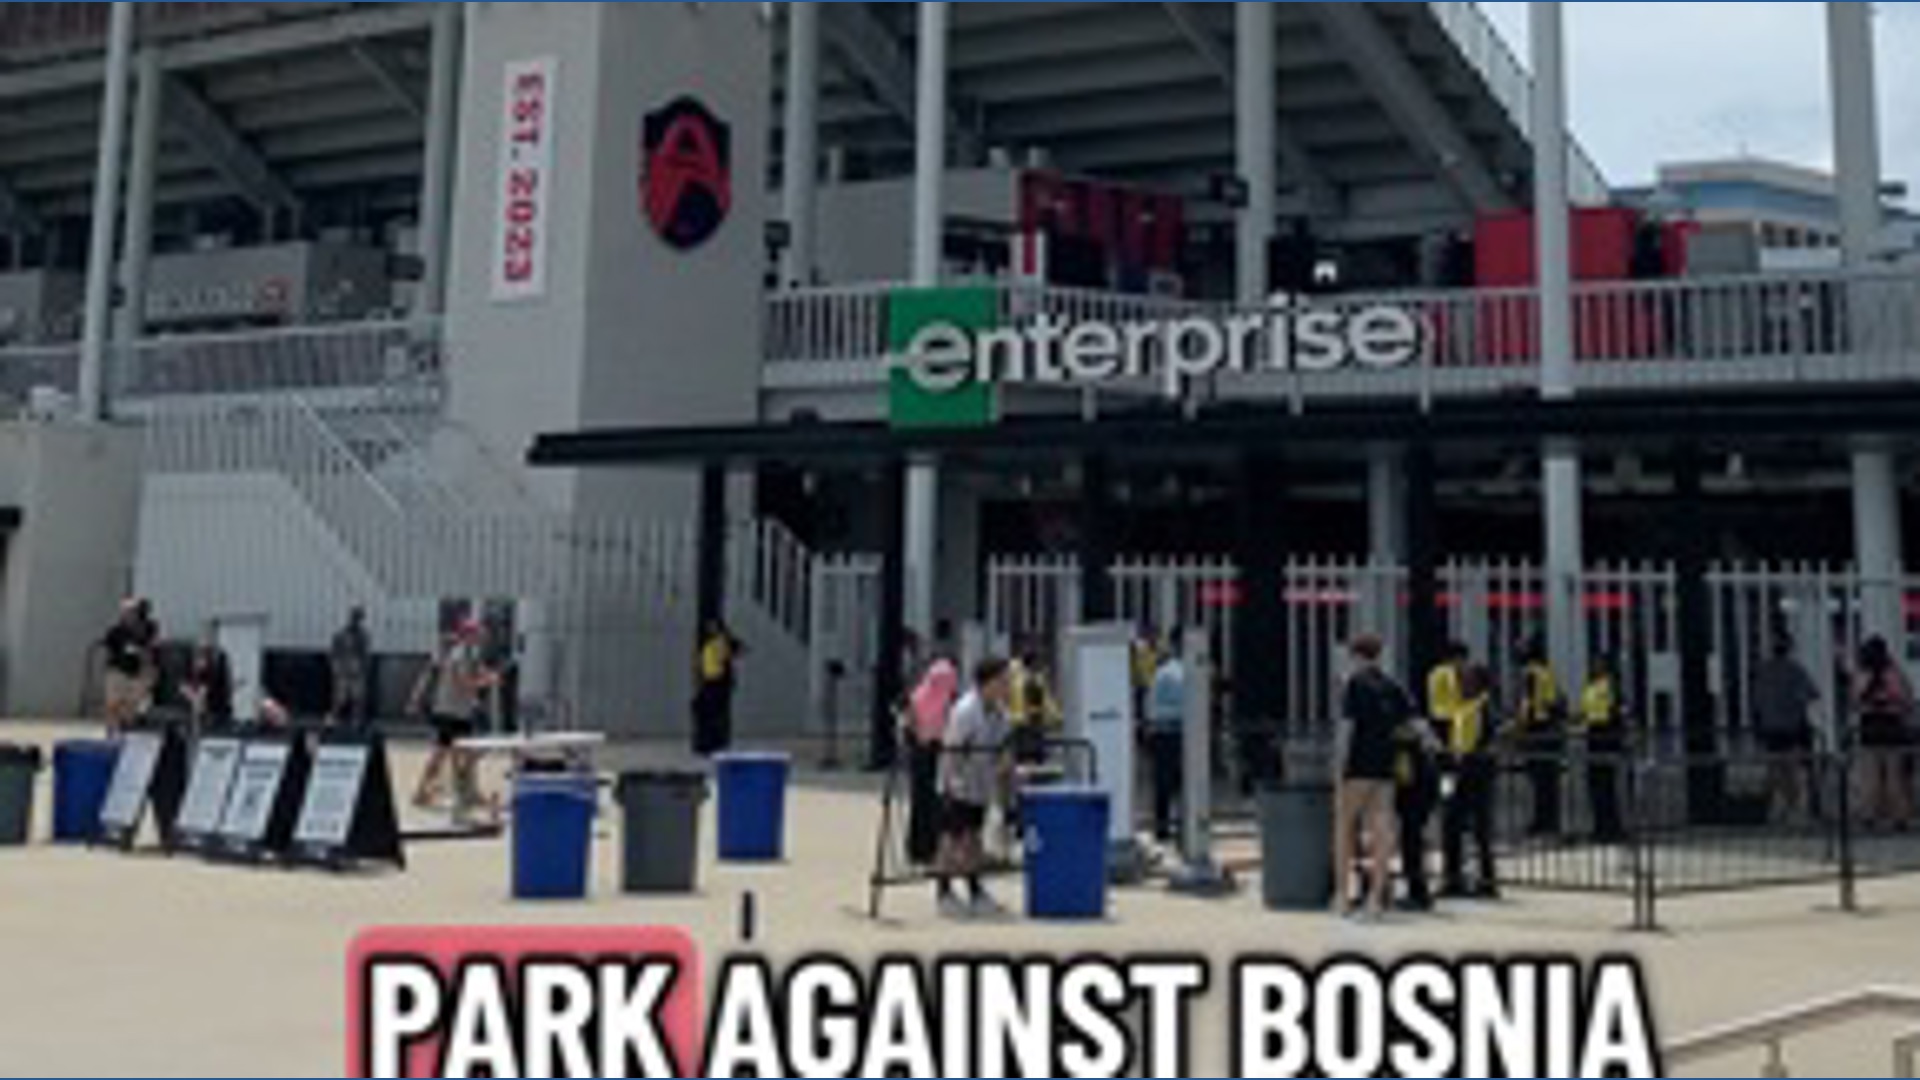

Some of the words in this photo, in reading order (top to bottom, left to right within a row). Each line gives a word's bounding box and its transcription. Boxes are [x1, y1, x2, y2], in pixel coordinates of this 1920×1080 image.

[512, 73, 543, 161] EST.
[504, 167, 538, 281] 2023
[888, 294, 1416, 396] enterprise
